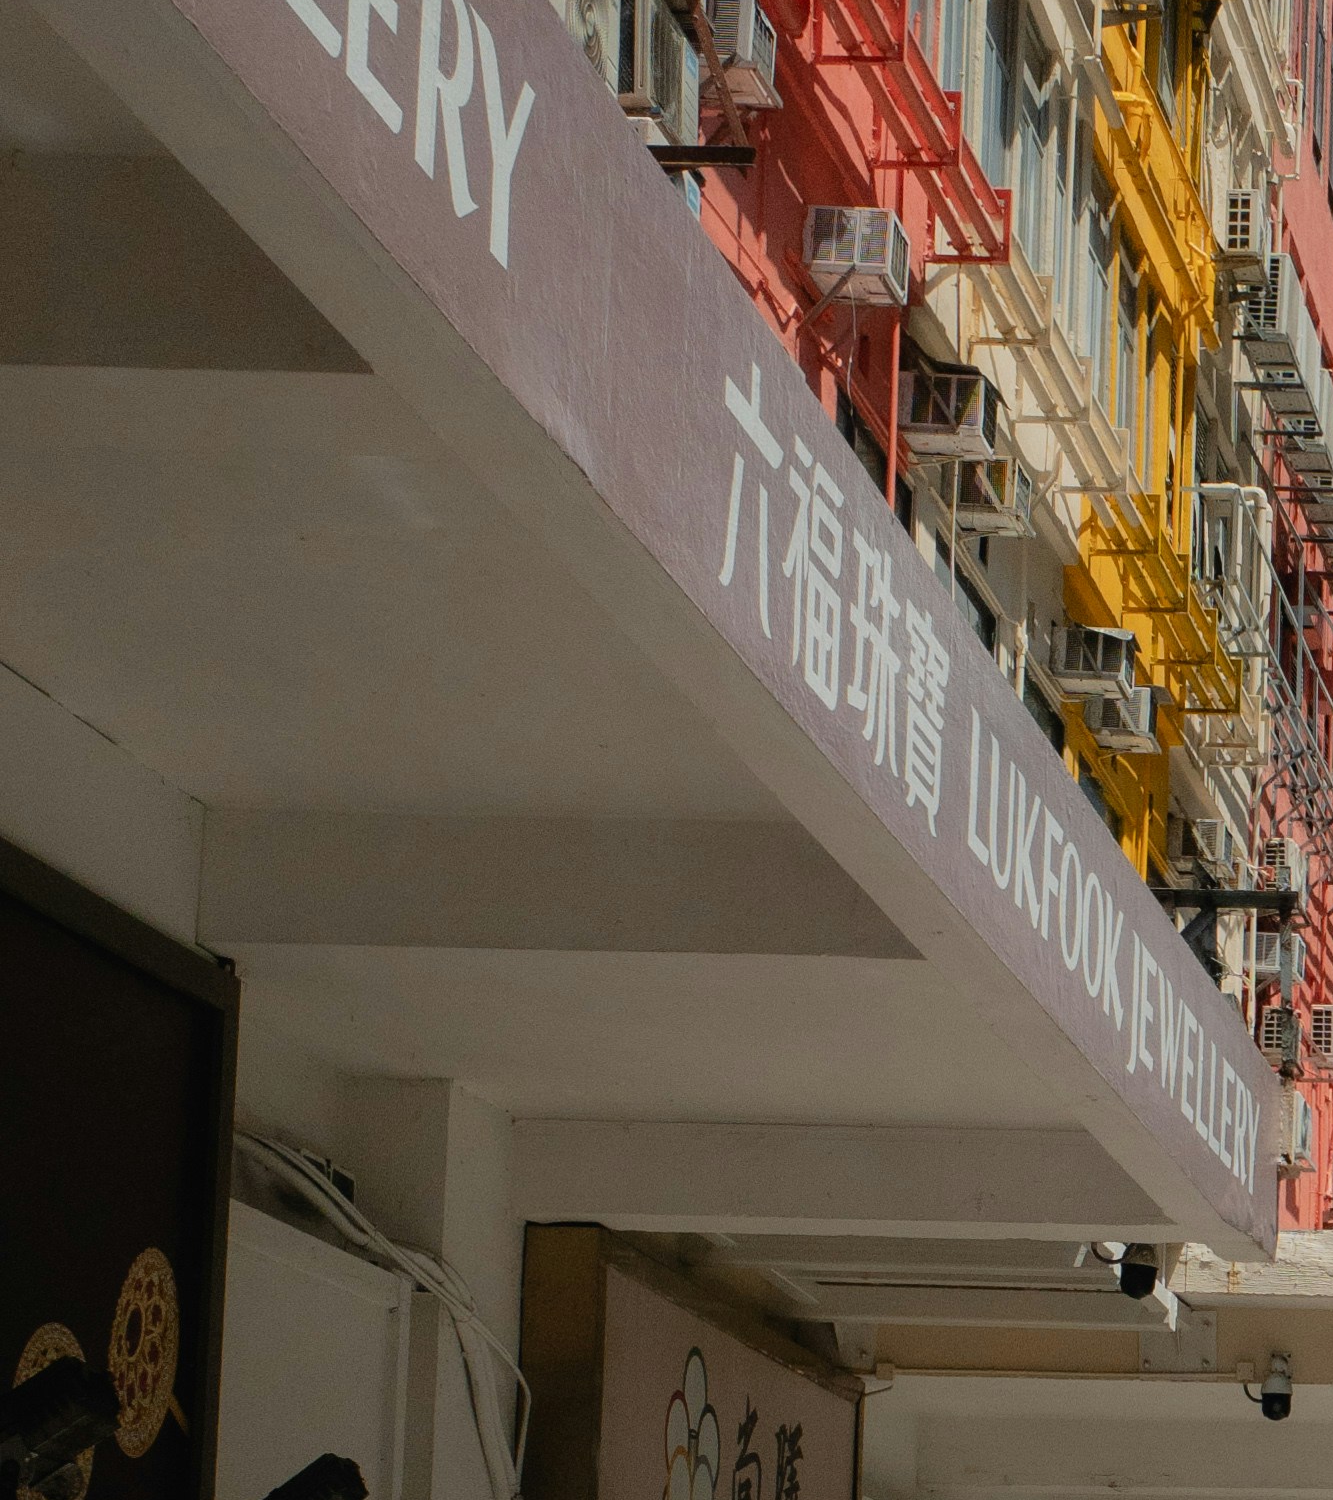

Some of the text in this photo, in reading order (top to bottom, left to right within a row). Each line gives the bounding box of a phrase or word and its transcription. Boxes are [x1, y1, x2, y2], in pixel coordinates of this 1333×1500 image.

[717, 364, 950, 838] 六福珠寶
[966, 708, 1260, 1194] LUKFOOK JEWELLERY
